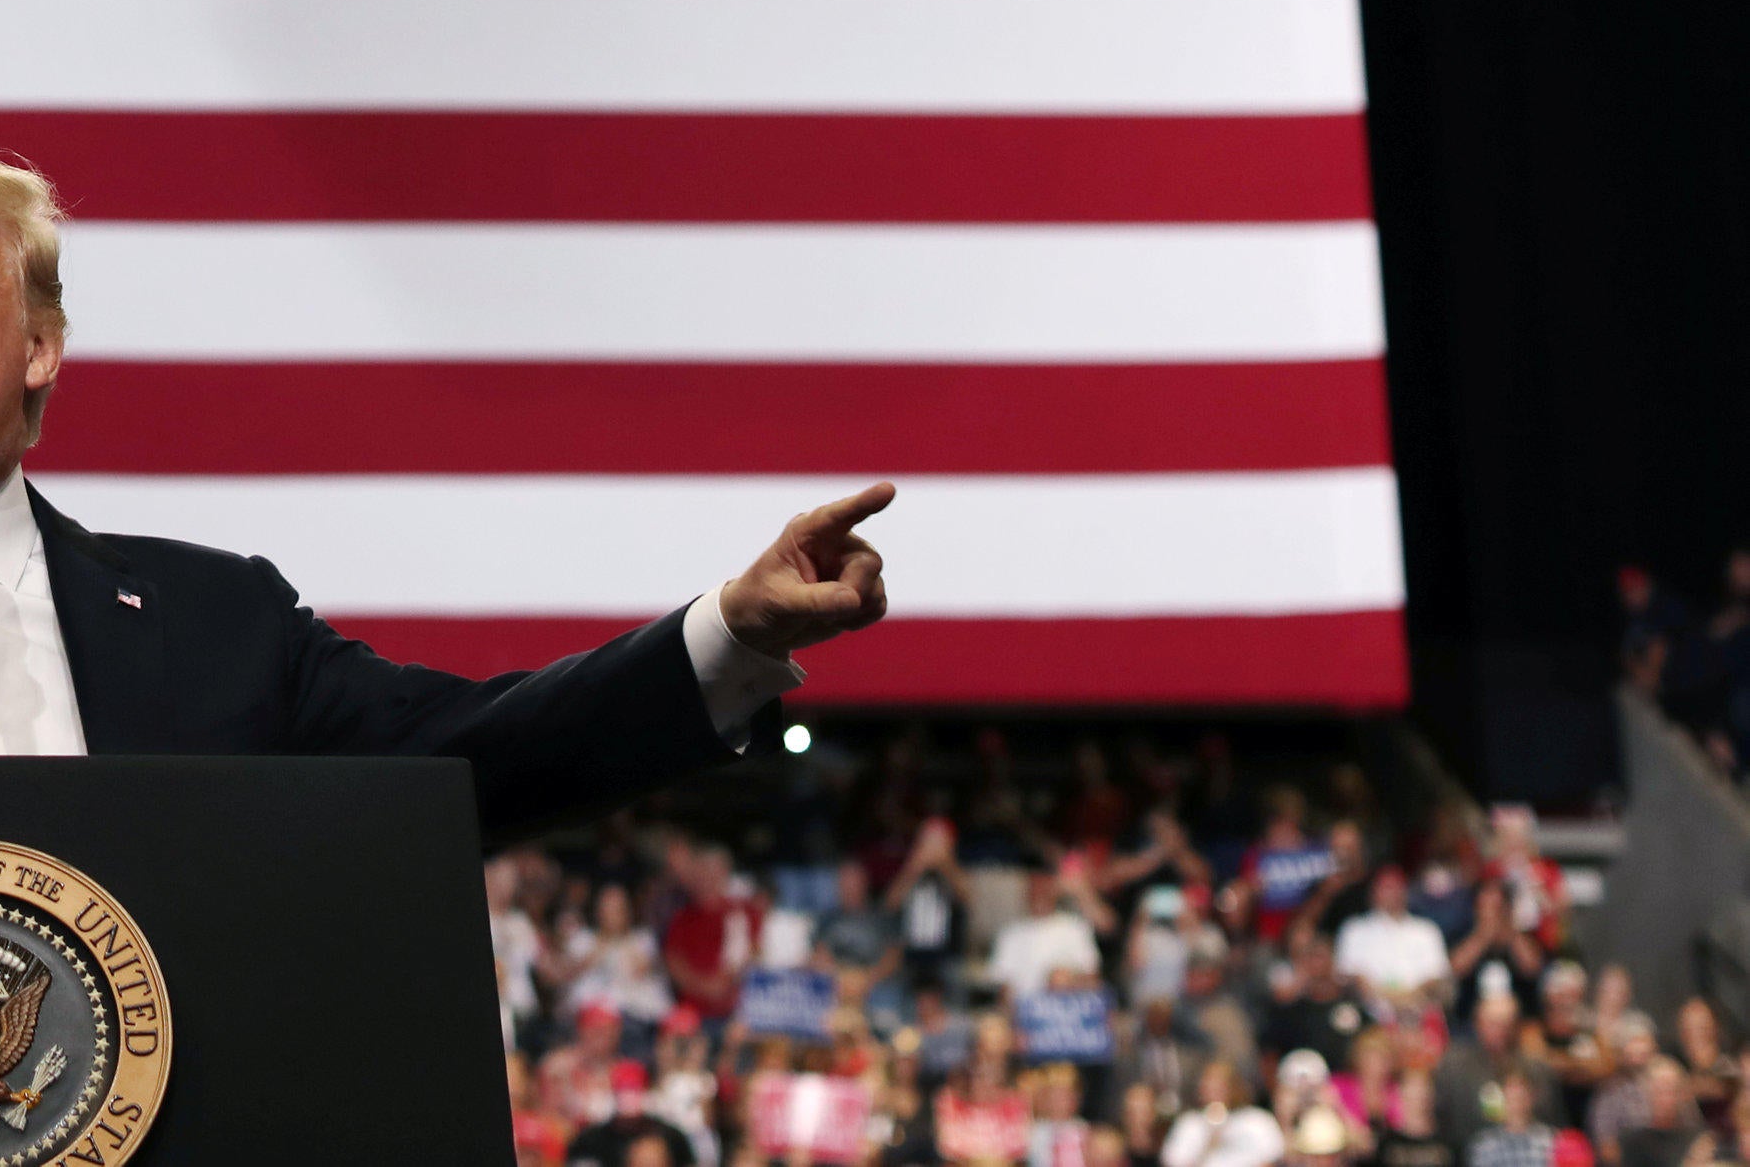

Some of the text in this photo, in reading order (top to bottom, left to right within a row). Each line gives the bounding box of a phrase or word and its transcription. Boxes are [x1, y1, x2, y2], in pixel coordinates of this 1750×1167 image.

[15, 865, 65, 903] THE
[74, 897, 159, 1057] UNITED
[55, 1094, 143, 1167] STA
